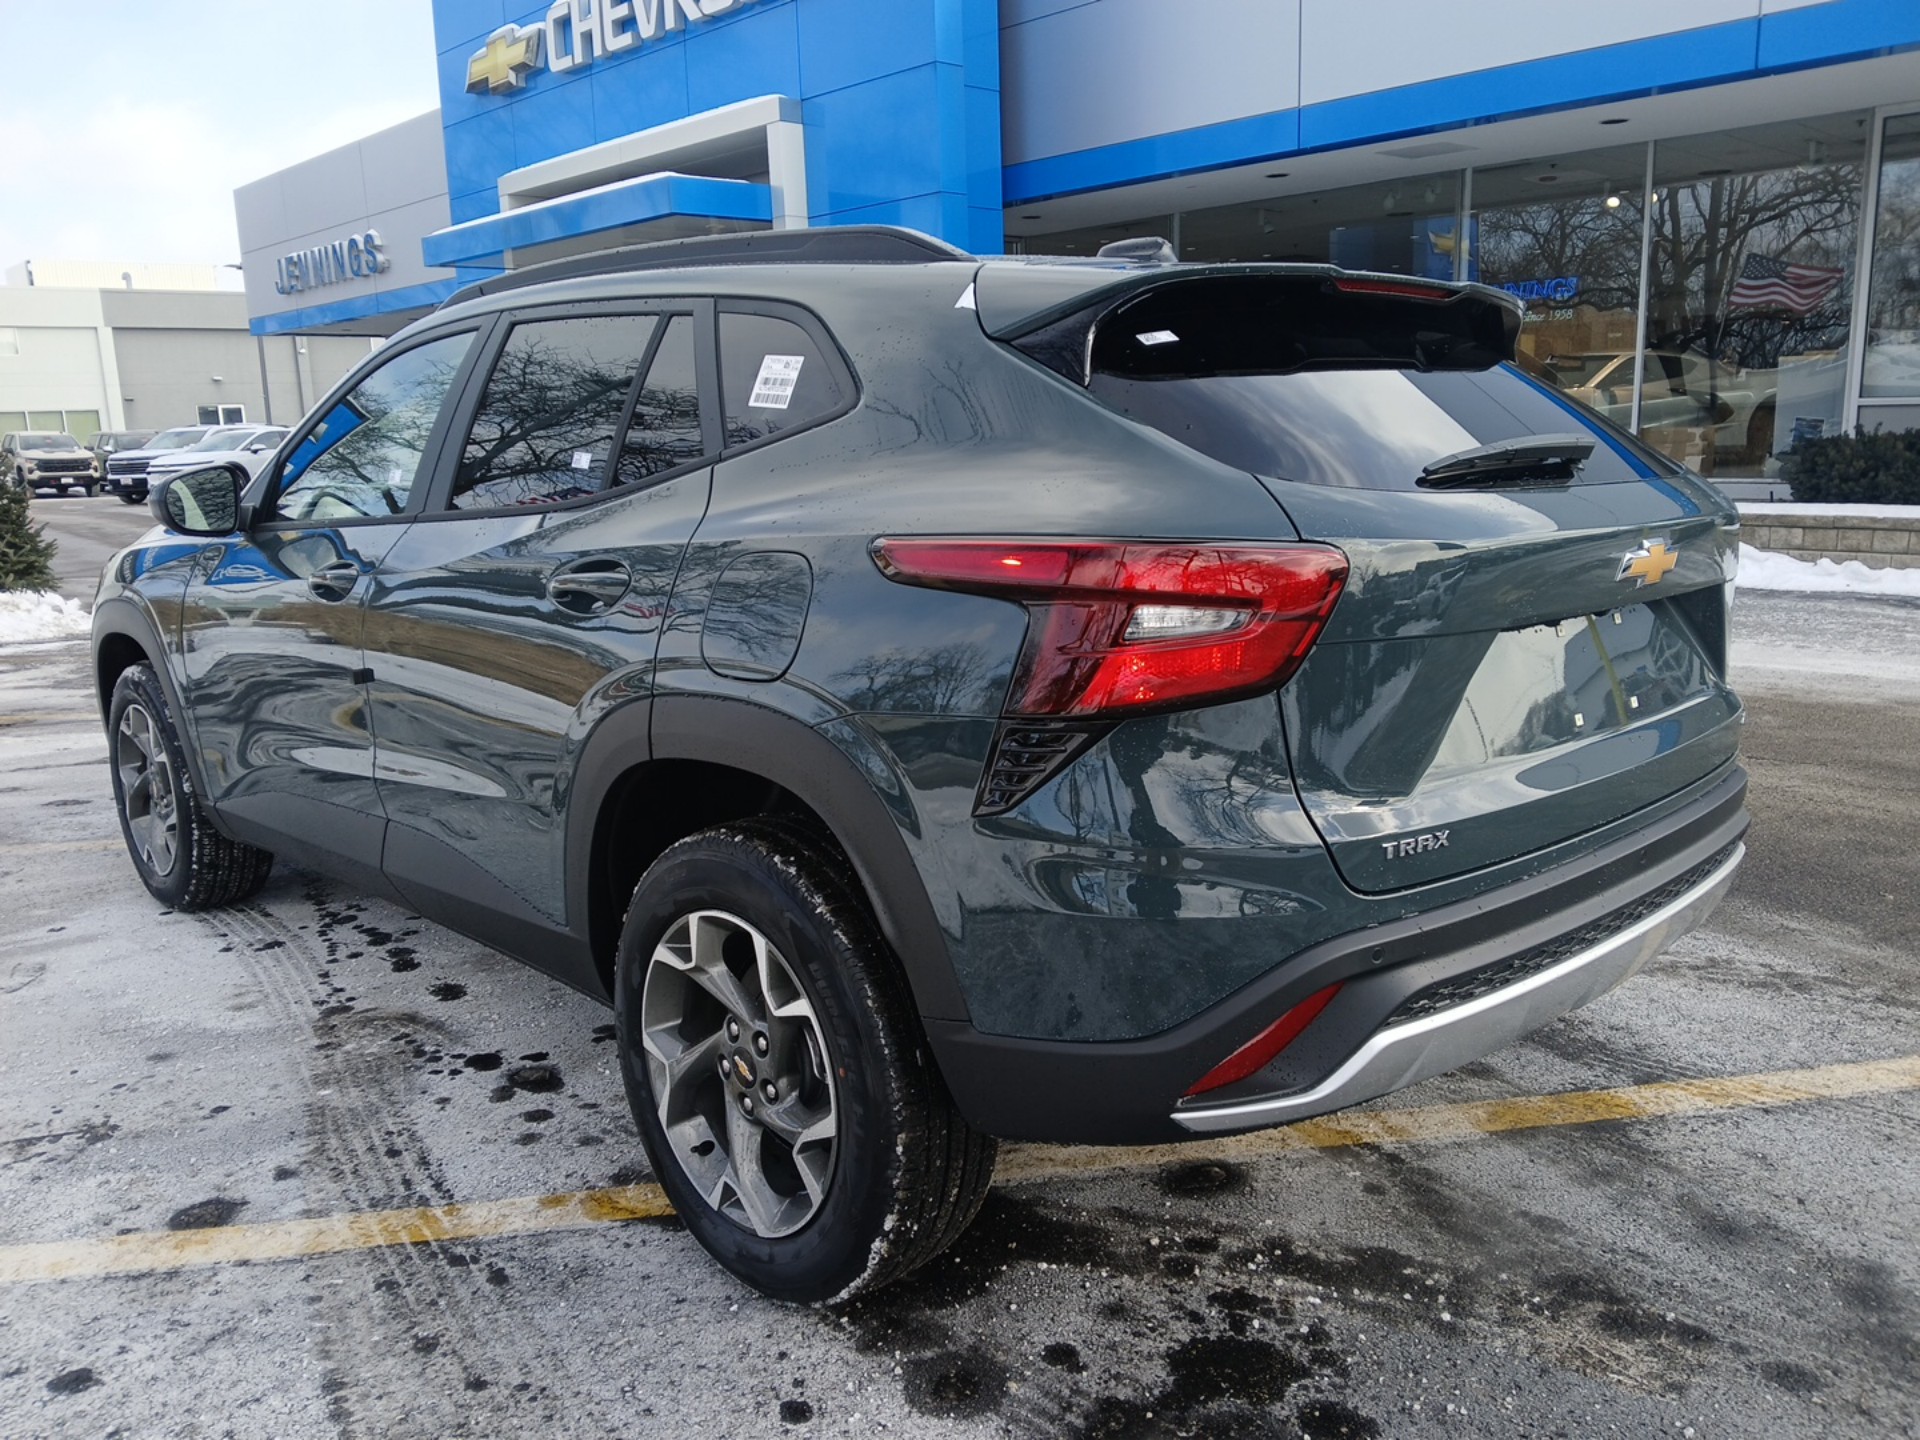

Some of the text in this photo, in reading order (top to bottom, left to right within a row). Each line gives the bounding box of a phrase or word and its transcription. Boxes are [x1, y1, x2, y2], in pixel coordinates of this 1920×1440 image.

[275, 230, 385, 295] JENNINGS
[1548, 308, 1573, 321] 1958
[1382, 829, 1450, 860] TRAX
